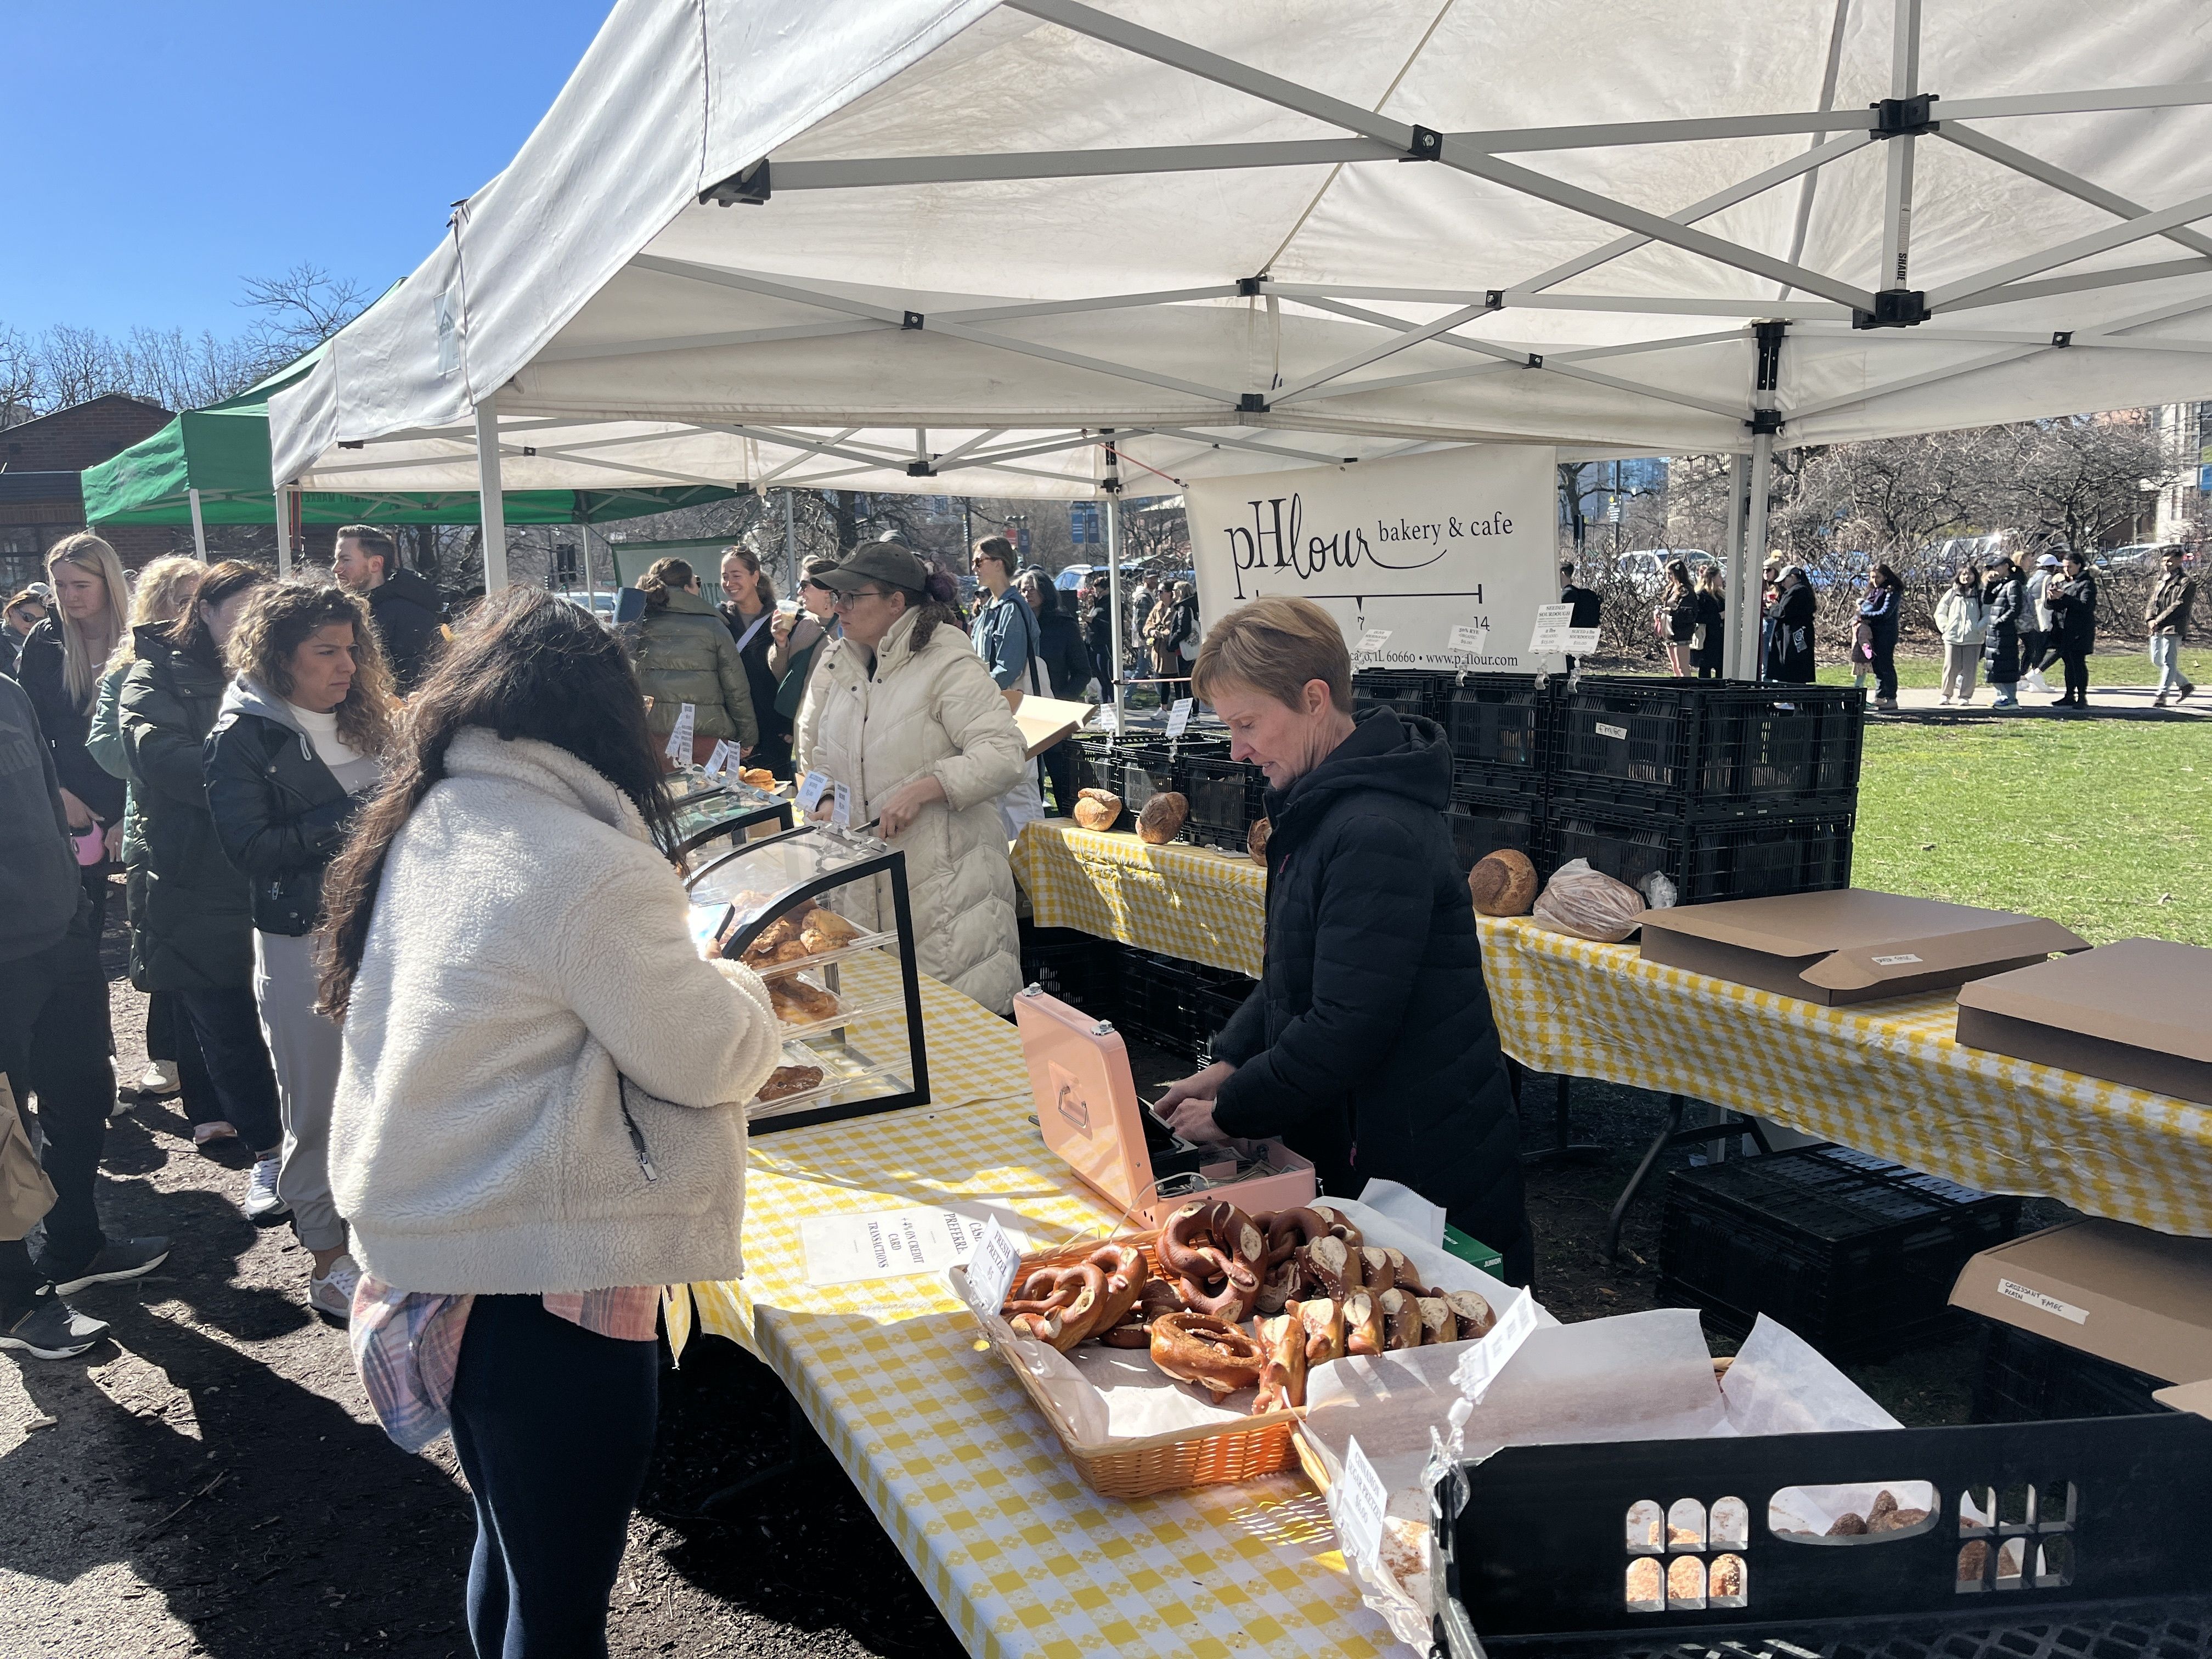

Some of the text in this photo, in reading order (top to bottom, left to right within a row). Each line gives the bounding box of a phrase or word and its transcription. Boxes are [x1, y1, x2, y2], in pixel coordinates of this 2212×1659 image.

[1897, 253, 1907, 281] SHADE
[1378, 511, 1514, 545] bakery & cafe
[1357, 616, 1365, 631] 7
[1474, 616, 1490, 631] 14
[1375, 650, 1385, 662] IL
[1386, 650, 1415, 663] 60660
[867, 1221, 889, 1268] TRANSACTIONS
[888, 1233, 902, 1250] CARD
[905, 1231, 917, 1240] ON
[944, 1212, 968, 1255] PREFERRE
[995, 1231, 1011, 1259] FRESH
[908, 1240, 924, 1263] CREDIT
[987, 1240, 1007, 1277] PRETZEL
[1483, 1257, 1502, 1268] JUNIOR
[2004, 1289, 2023, 1300] PLAIN
[2005, 1282, 2041, 1299] CROISSANT
[1355, 1451, 1380, 1498] CINNAMON
[1348, 1459, 1382, 1525] SUGAR PRETZEL
